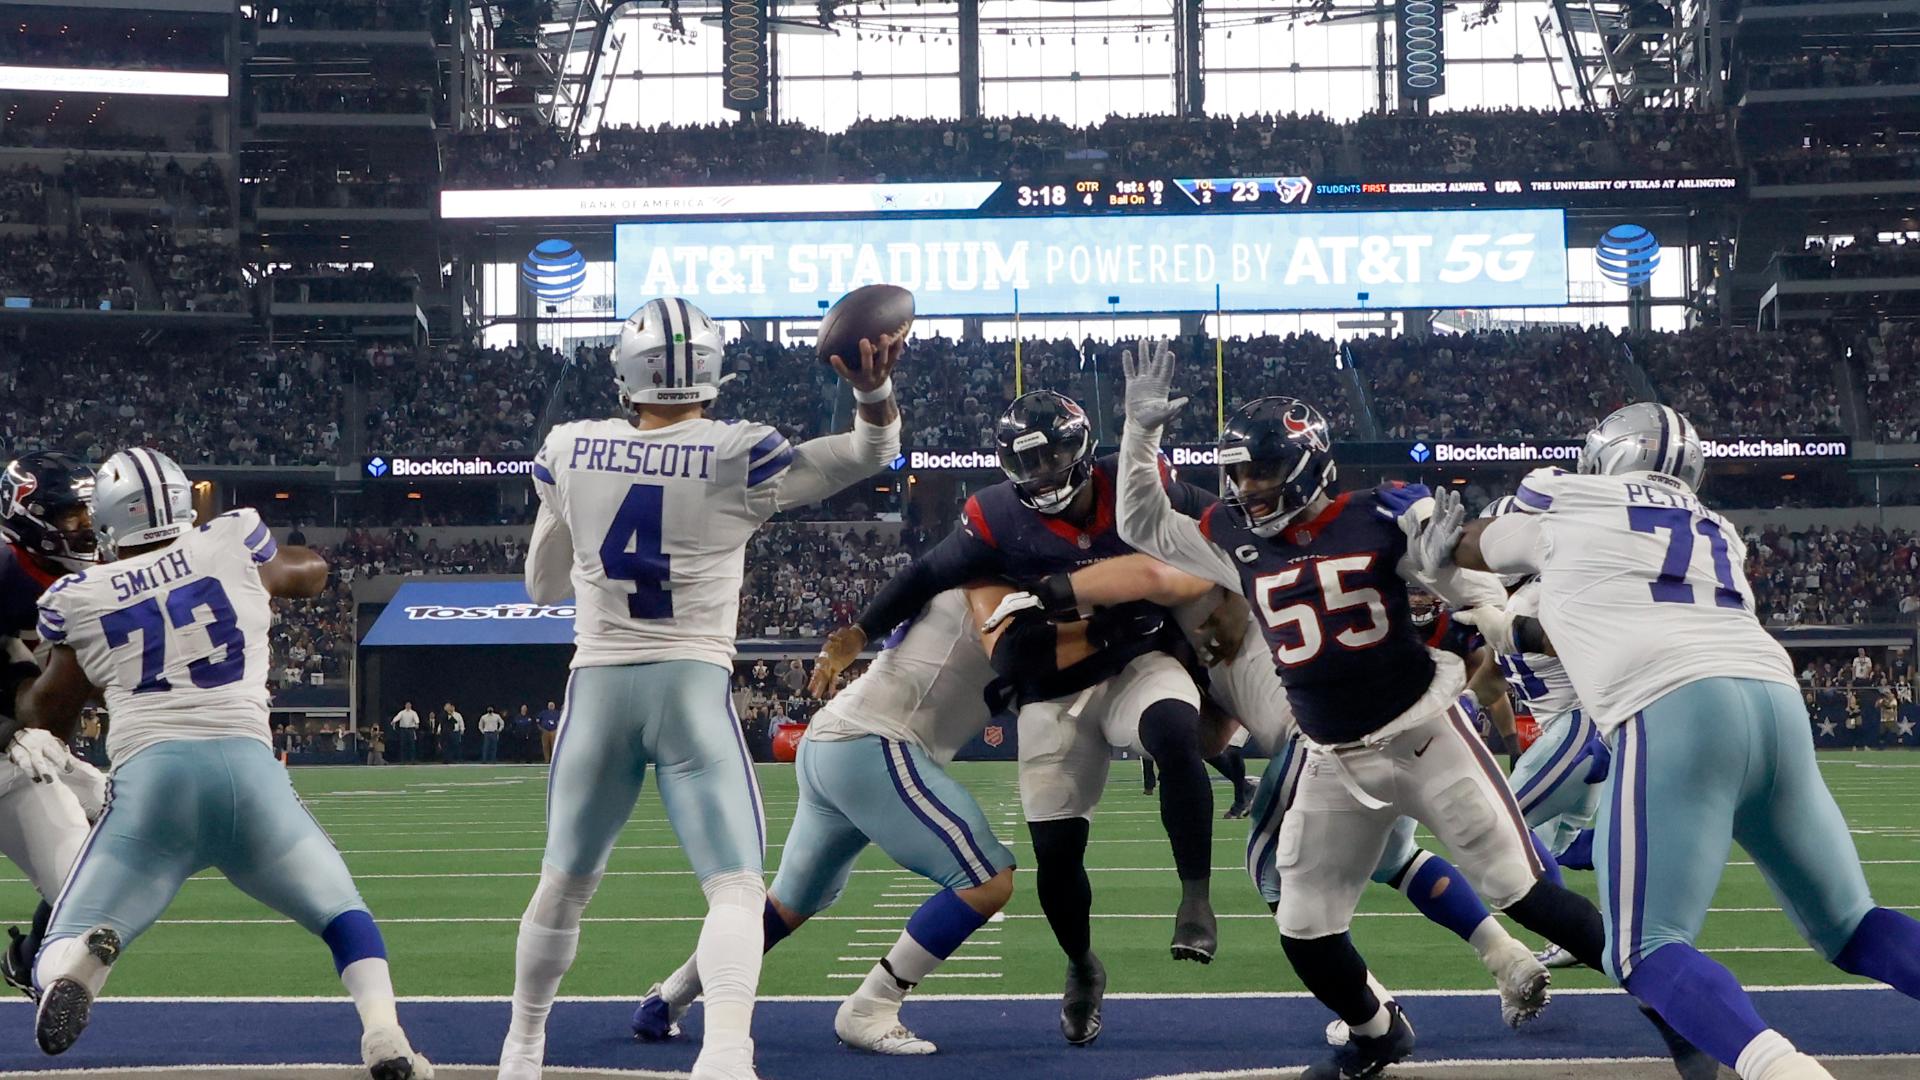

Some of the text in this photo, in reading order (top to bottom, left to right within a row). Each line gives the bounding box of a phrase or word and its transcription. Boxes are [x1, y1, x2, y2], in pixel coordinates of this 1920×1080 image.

[1076, 181, 1100, 192] QTR
[1148, 180, 1164, 193] 10
[1194, 179, 1216, 190] TOL
[1232, 181, 1260, 202] 23
[1316, 184, 1361, 194] STUDENTS
[1389, 182, 1447, 193] EXCELLENCE
[1448, 182, 1487, 192] ALWAYS.
[1495, 181, 1522, 193] UTA
[1531, 181, 1551, 191] THE
[1553, 180, 1612, 190] UNIVERSITY
[1614, 180, 1628, 190] OF
[1629, 179, 1661, 190] TEXAS
[1662, 179, 1675, 189] AT
[1677, 178, 1736, 189] ARLINGTON
[580, 199, 704, 209] BANK OF AMERICA
[1018, 186, 1066, 206] 3:18
[1083, 193, 1093, 206] 4
[1109, 192, 1162, 206] Ball On 2
[1202, 191, 1211, 203] 2
[640, 233, 1536, 295] AT&T STADIUM POWERED BY AT&T 5G
[569, 437, 715, 479] PRESCOTT
[911, 450, 1000, 469] Blockchai
[1435, 442, 1581, 461] Blockchain.com
[1700, 440, 1846, 460] Blockchain.com
[392, 457, 535, 476] Blockchain.com
[600, 484, 674, 620] 4
[1234, 544, 1260, 564] C
[1627, 505, 1746, 611] 71
[110, 549, 192, 602] SMITH
[404, 603, 577, 620] TOSTITO
[1255, 553, 1390, 665] 55
[100, 576, 246, 696] 73
